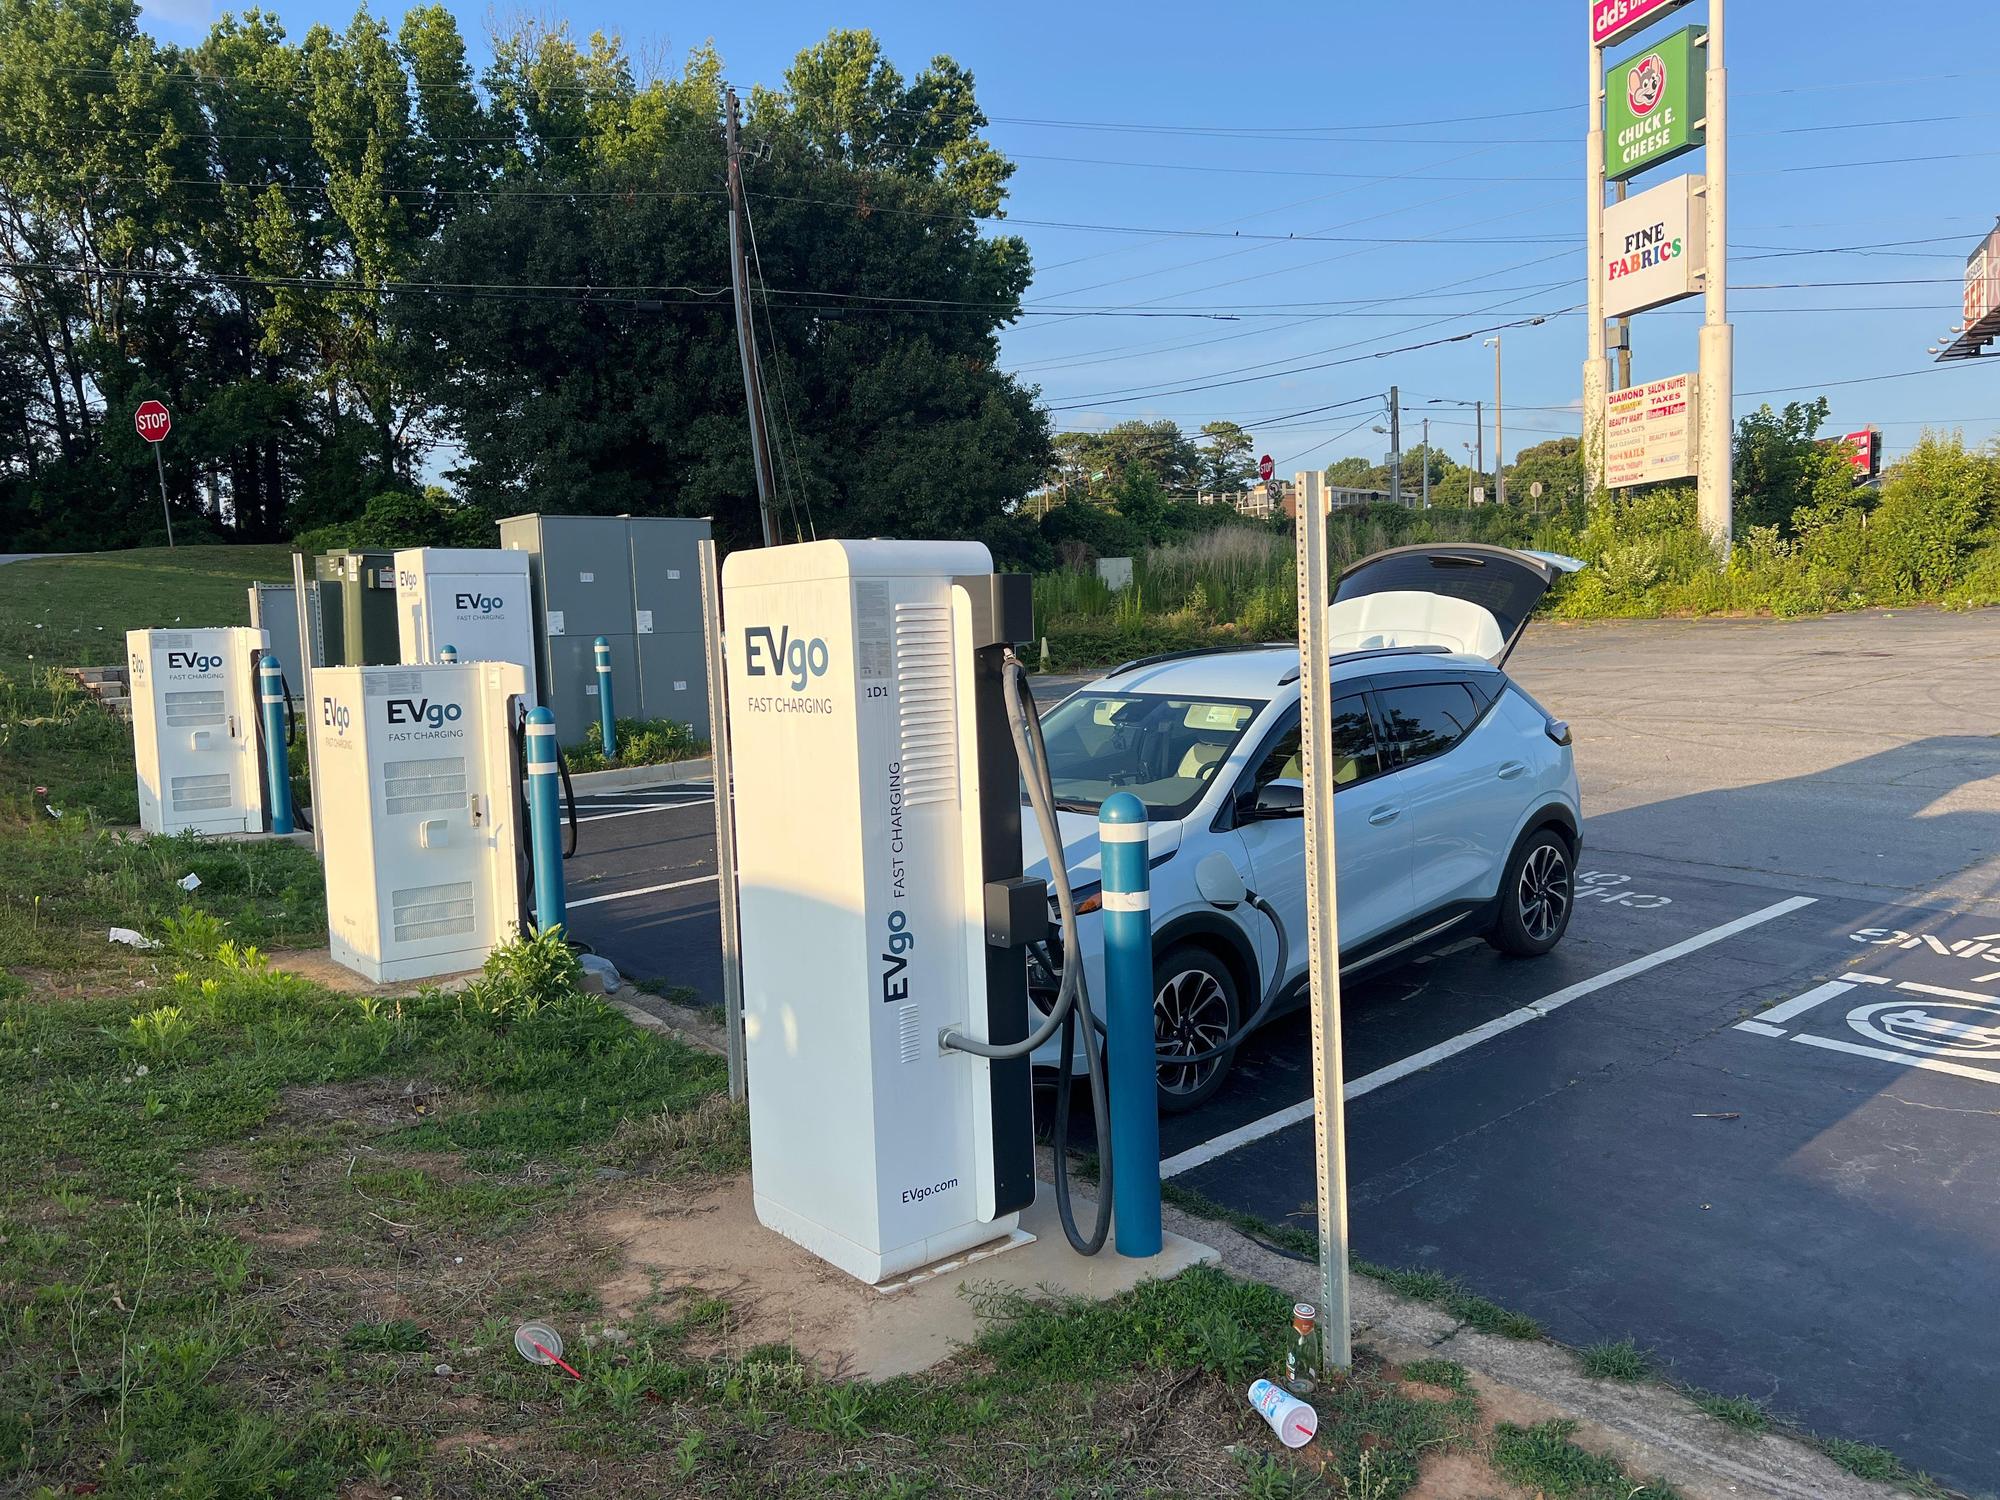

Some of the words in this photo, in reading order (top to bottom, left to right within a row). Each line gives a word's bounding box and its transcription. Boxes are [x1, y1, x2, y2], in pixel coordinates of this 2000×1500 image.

[1596, 0, 1628, 33] dd's
[1618, 116, 1662, 147] CHUCK
[1664, 107, 1676, 125] E.
[1623, 128, 1670, 163] CHEESE
[1624, 222, 1665, 254] FINE
[1608, 237, 1682, 281] FABRICS
[1608, 389, 1644, 405] DIAMOND
[1647, 383, 1665, 395] SALON
[1667, 376, 1686, 391] SUITES
[1651, 392, 1681, 405] TAXES
[138, 412, 167, 430] STOP
[400, 571, 417, 590] EVgo
[455, 593, 503, 613] EVgo
[168, 652, 223, 672] EVgo
[744, 625, 829, 692] EVgo
[748, 697, 772, 713] FAST
[775, 697, 832, 715] CHARGING
[866, 686, 889, 698] 1D1
[323, 697, 350, 736] EVgo
[387, 699, 462, 729] EVgo
[388, 732, 412, 742] FAST
[413, 729, 464, 741] CHARGING
[888, 761, 904, 853] CHARGING
[893, 857, 906, 899] FAST
[882, 910, 914, 1003] EVgo
[902, 1176, 958, 1204] EVgo.com
